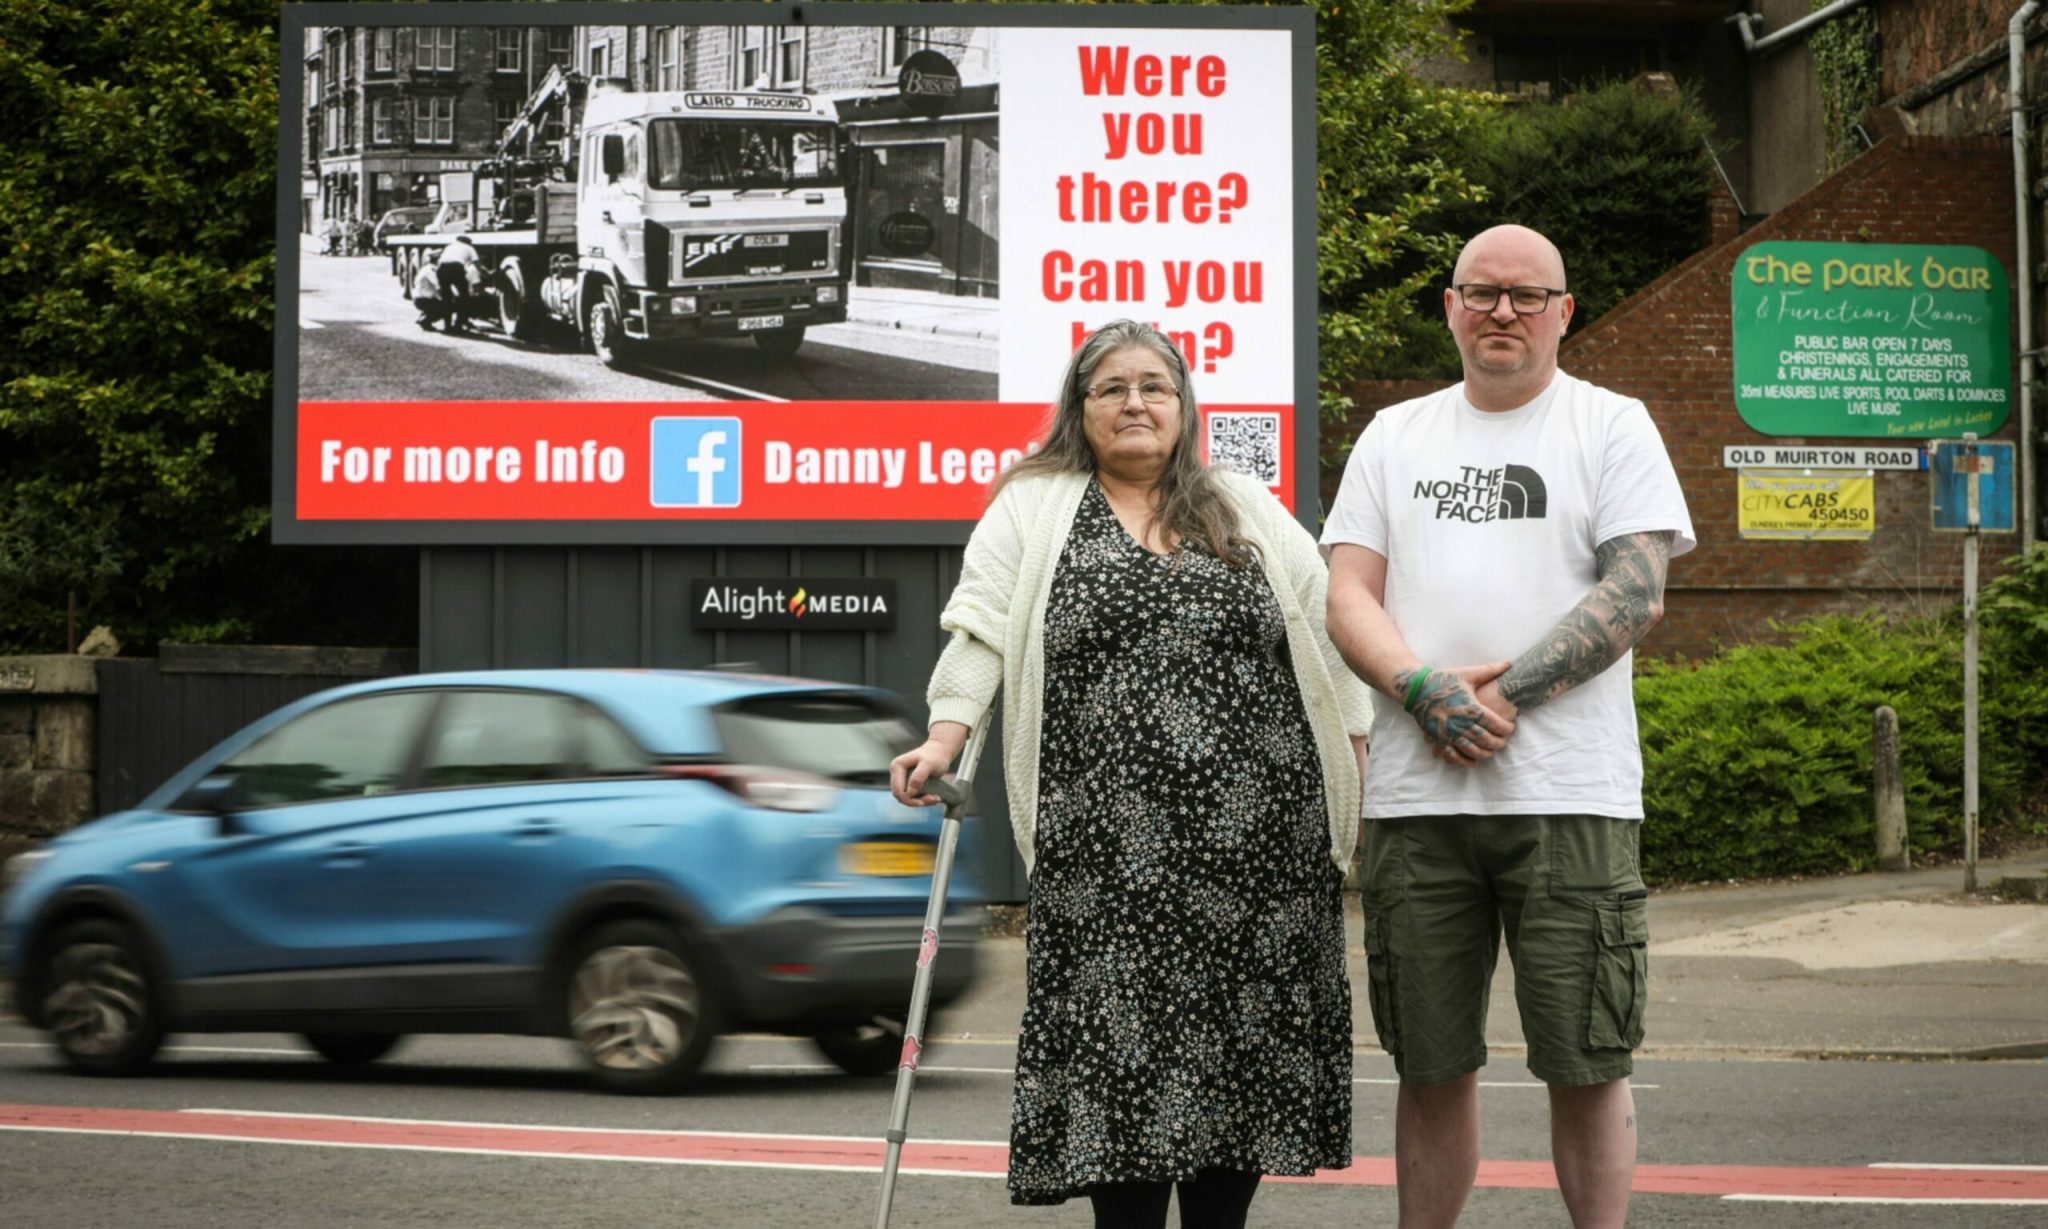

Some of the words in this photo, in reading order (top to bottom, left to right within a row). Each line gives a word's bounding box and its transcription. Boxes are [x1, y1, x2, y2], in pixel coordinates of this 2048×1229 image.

[1078, 46, 1226, 97] Were
[691, 93, 735, 107] LAIRD
[745, 97, 804, 109] TRUCKING
[1103, 113, 1202, 160] you
[1056, 172, 1248, 224] there?
[1042, 250, 1145, 302] Can
[1162, 261, 1262, 308] you
[1778, 289, 1898, 324] Function
[1902, 291, 1983, 331] Room
[1794, 335, 1839, 349] PUBLIC
[1842, 336, 1869, 350] BAR
[1872, 337, 1907, 351] OPEN
[1911, 338, 1918, 351] 7
[1922, 338, 1952, 352] DAYS
[1876, 353, 1968, 368] ENGAGEMENTS
[1777, 367, 1786, 380] &
[1790, 367, 1857, 381] FUNERALS
[1860, 368, 1882, 381] ALL
[1886, 369, 1943, 383] CATERED
[1946, 370, 1972, 383] FOR
[1764, 385, 1817, 399] MEASURES
[1819, 386, 1840, 399] LIVE
[1885, 387, 1911, 400] POOL
[1914, 388, 1945, 401] DARTS
[1947, 388, 1954, 401] &
[1956, 388, 2006, 402] DOMINOES
[1847, 402, 1869, 415] LIVE
[1871, 402, 1901, 415] MUSIC
[321, 440, 391, 483] For
[404, 446, 521, 483] more
[535, 440, 625, 483] Info
[765, 441, 906, 488] Danny
[1731, 450, 1765, 464] OLD
[1775, 450, 1855, 465] MUIRTON
[1865, 451, 1913, 465] ROAD
[1460, 466, 1504, 487] THE
[1413, 480, 1501, 505] NORTH
[1435, 500, 1498, 524] FACE
[1808, 508, 1869, 520] 450450
[701, 586, 786, 619] Alight
[809, 595, 887, 613] MEDIA
